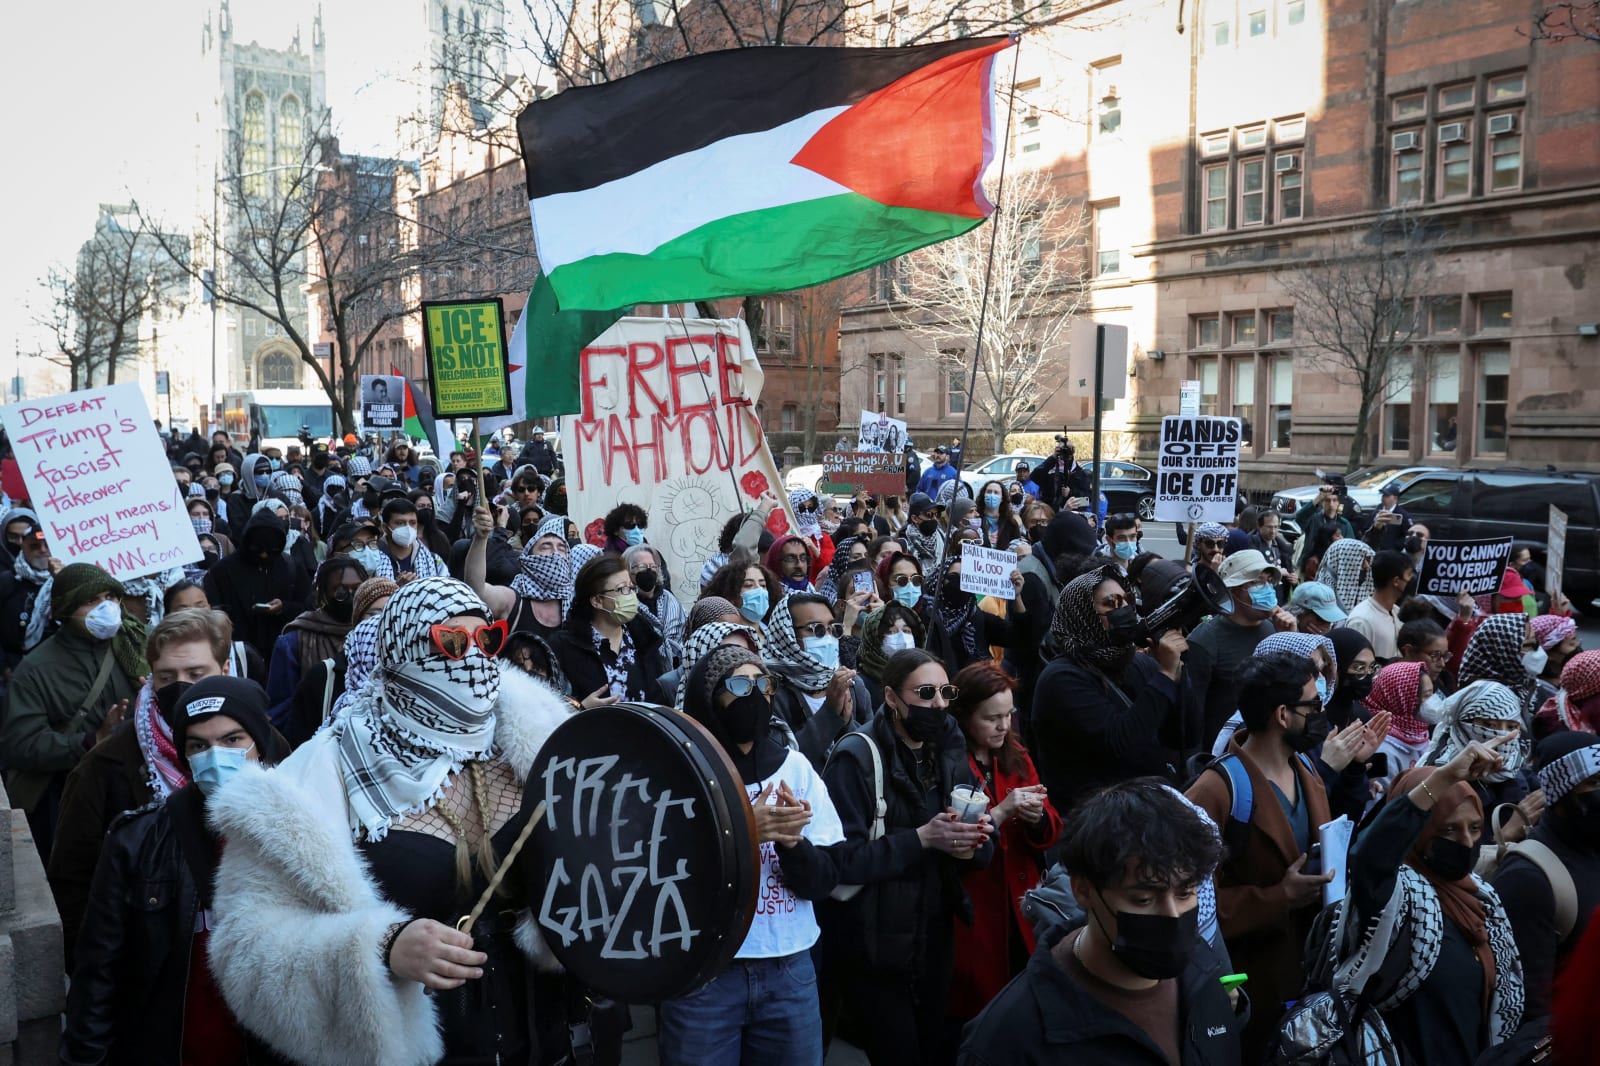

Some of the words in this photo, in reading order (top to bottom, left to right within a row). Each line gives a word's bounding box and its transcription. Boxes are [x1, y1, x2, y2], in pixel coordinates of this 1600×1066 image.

[441, 308, 487, 344] ICE
[436, 344, 456, 370] IS
[459, 342, 496, 369] NOT
[438, 368, 478, 380] WELCOME
[478, 367, 498, 378] HERE!
[579, 332, 753, 423] FREE
[18, 397, 106, 428] DEFEAT
[16, 409, 138, 453] Trump's
[1164, 420, 1239, 442] HANDS
[574, 403, 762, 491] MAHMOUD
[1164, 443, 1236, 456] OFF
[34, 447, 123, 497] fascist
[823, 464, 852, 472] CAN'T
[854, 464, 874, 474] HIDE
[884, 466, 904, 474] FROM
[1162, 456, 1182, 468] OUR
[1186, 457, 1236, 468] STUDENTS
[44, 479, 131, 513] takeover
[1160, 472, 1194, 496] ICE
[1200, 474, 1236, 496] OFF
[50, 520, 77, 548] by
[79, 513, 110, 535] any
[68, 519, 159, 556] necessary
[964, 544, 984, 558] ISRAEL
[986, 550, 1016, 564] MURDERED
[1427, 545, 1457, 560] YOU
[1460, 542, 1510, 561] CANNOT
[1427, 575, 1498, 592] GENOCIDE
[1437, 560, 1498, 578] COVERUP
[541, 754, 696, 886] FREE
[539, 857, 701, 959] GAZA
